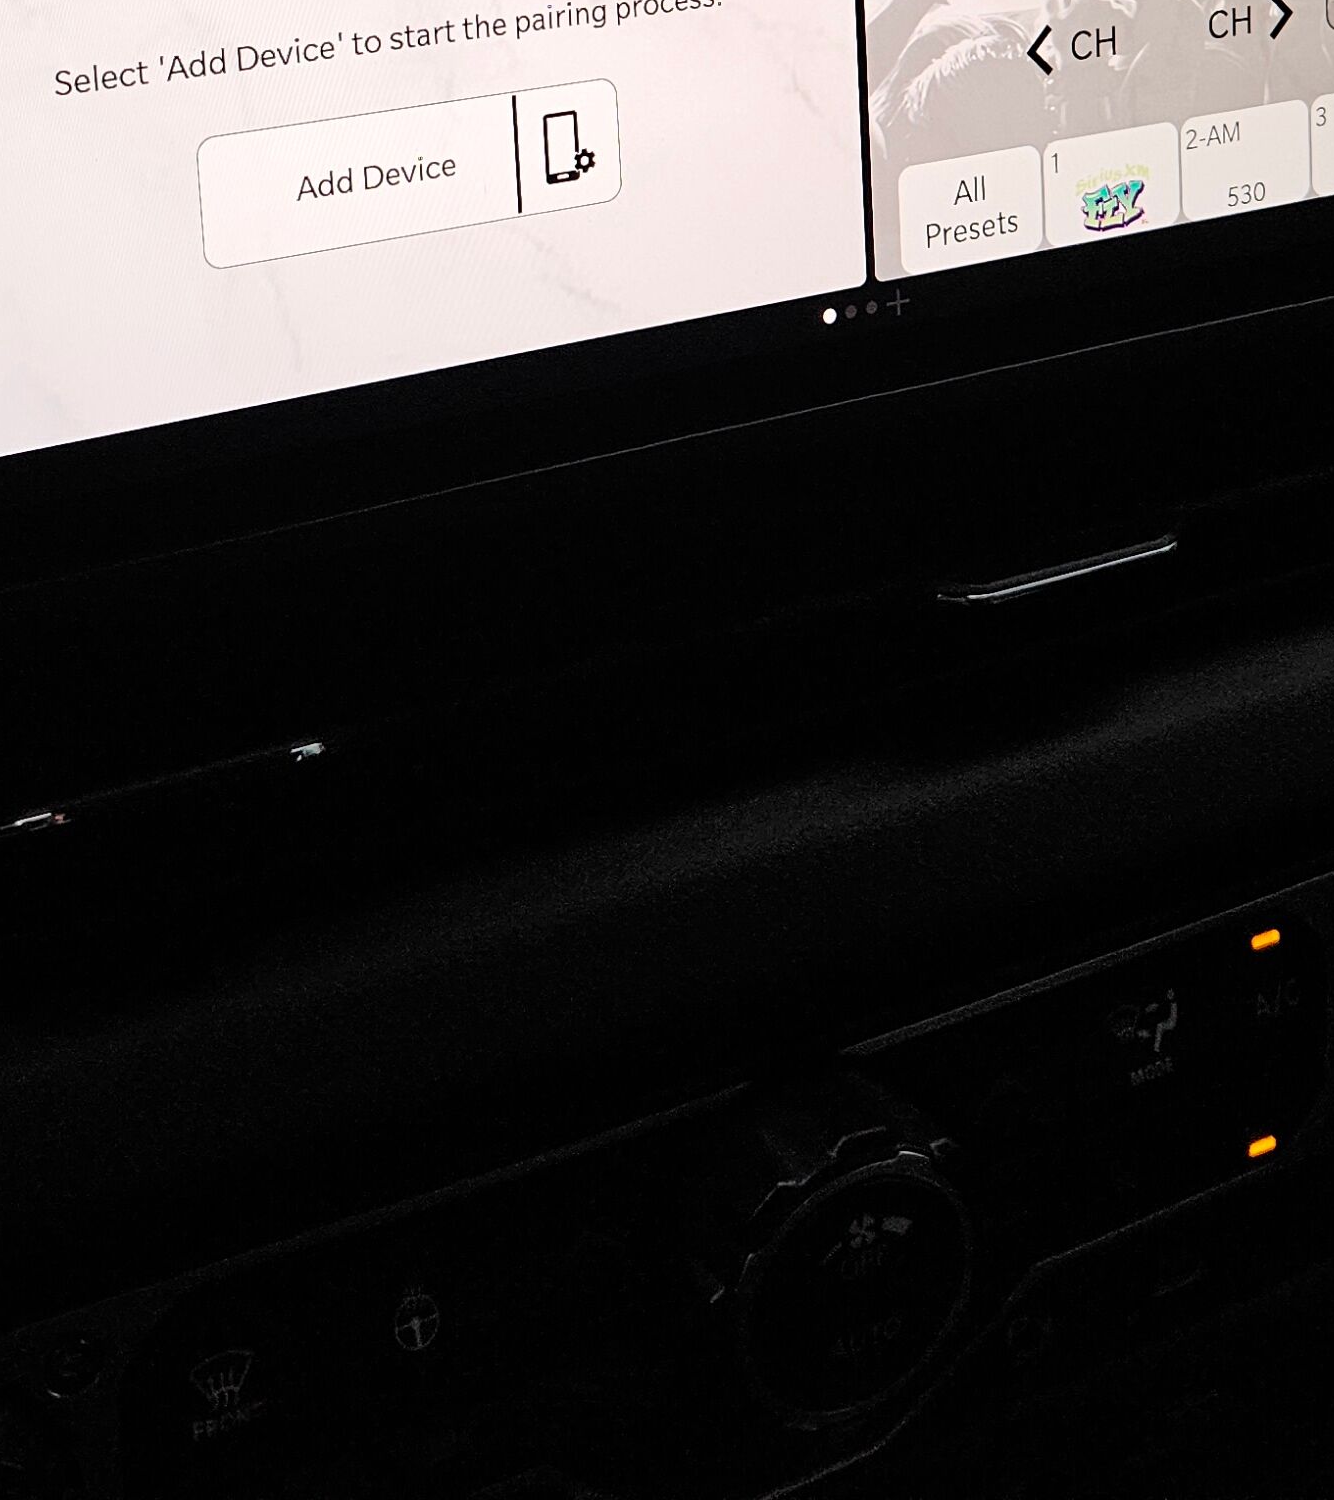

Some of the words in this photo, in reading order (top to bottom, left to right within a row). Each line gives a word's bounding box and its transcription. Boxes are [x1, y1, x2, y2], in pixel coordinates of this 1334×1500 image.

[1209, 6, 1251, 38] CH
[56, 62, 148, 95] Select
[352, 33, 381, 55] to
[390, 21, 455, 50] start
[462, 14, 506, 39] the
[516, 2, 605, 39] pairing
[1072, 26, 1116, 60] CH
[1316, 107, 1326, 126] 3
[1187, 122, 1239, 149] 2-AM
[1051, 152, 1059, 174] 1
[297, 170, 353, 202] Add
[364, 157, 455, 189] Device
[954, 176, 985, 205] All
[1227, 181, 1267, 208] 530
[927, 212, 1017, 248] Presets
